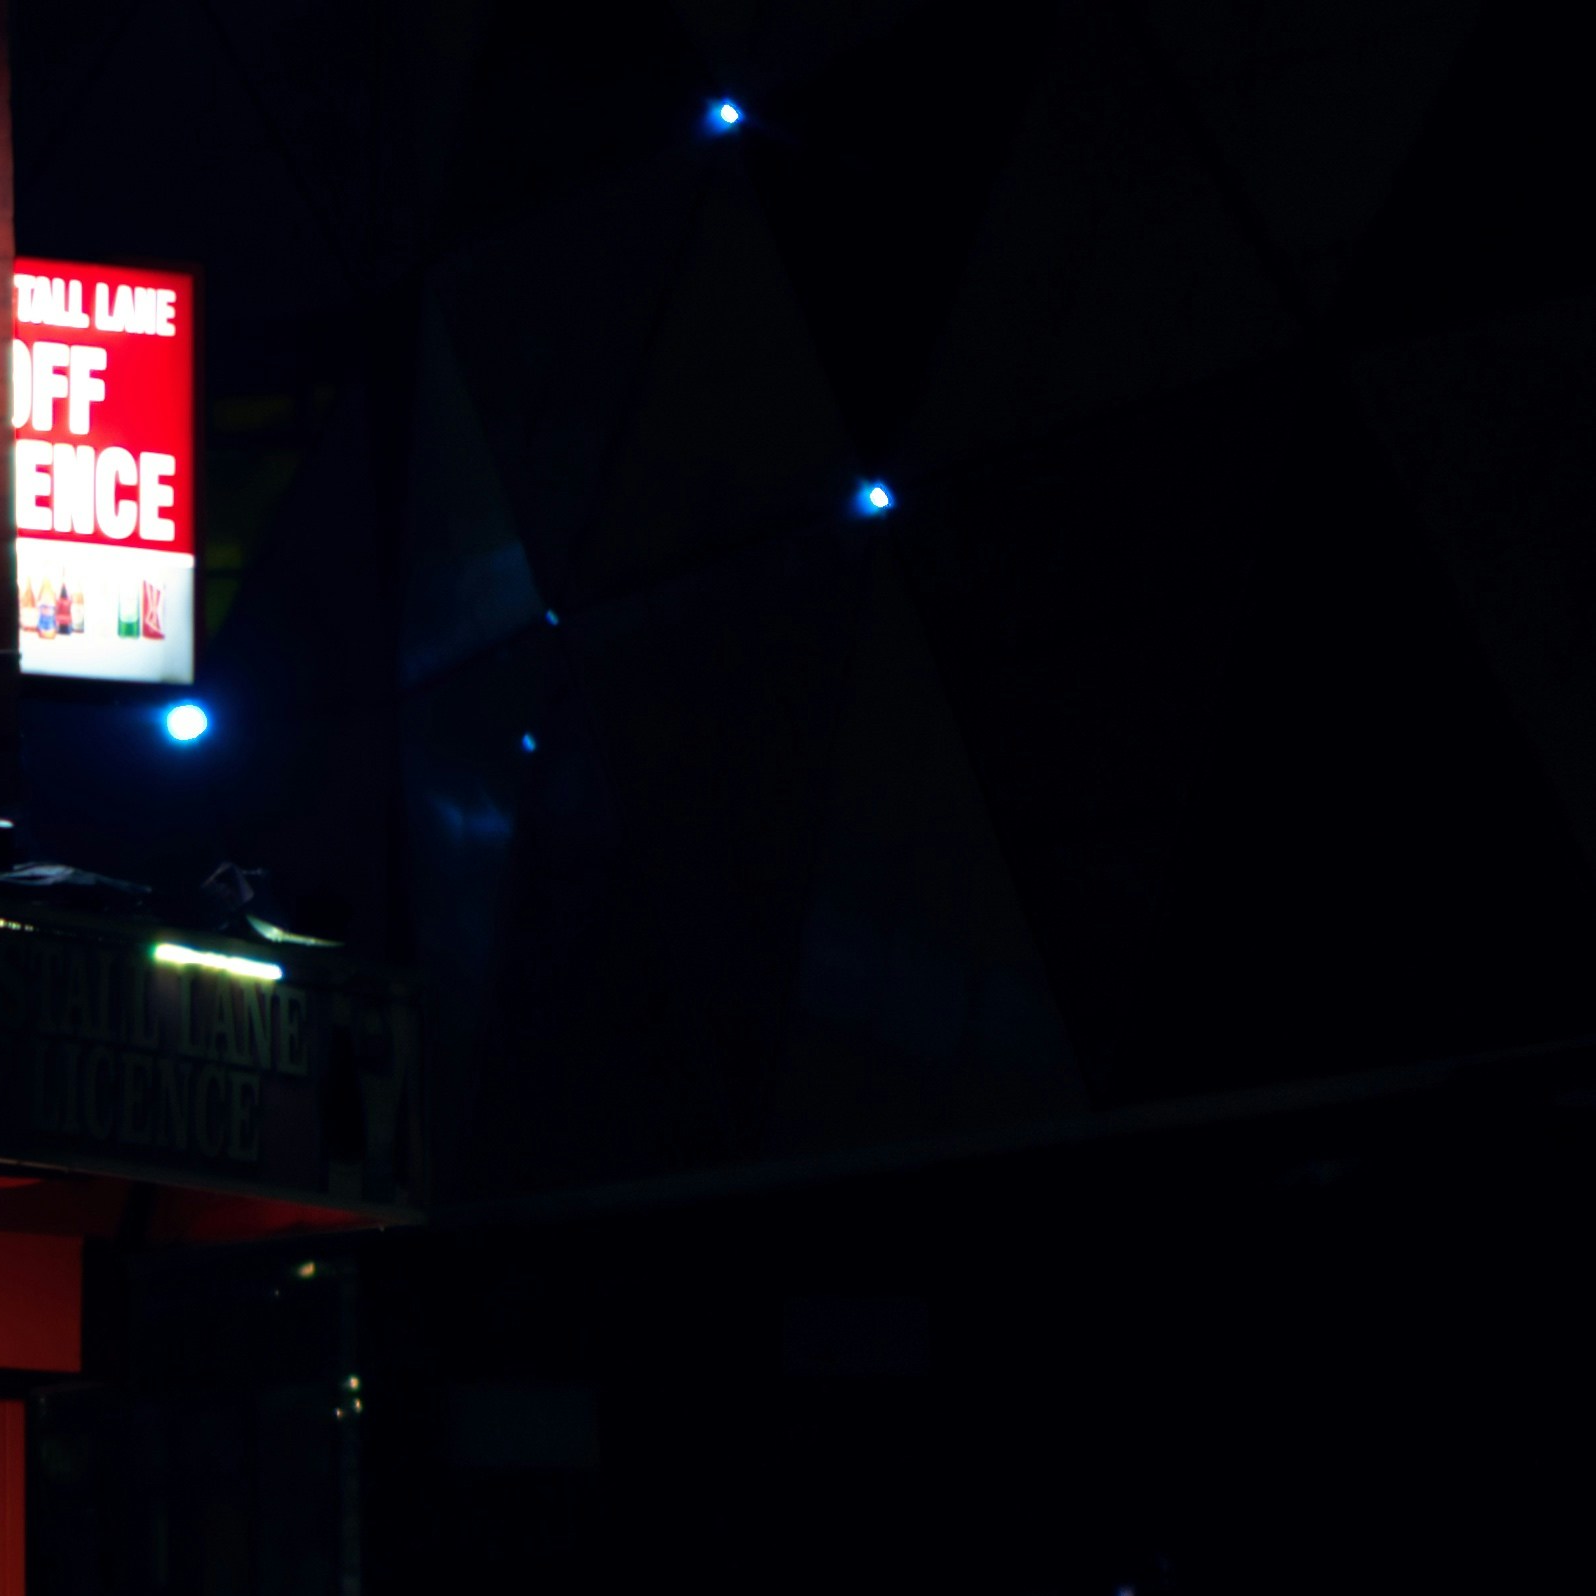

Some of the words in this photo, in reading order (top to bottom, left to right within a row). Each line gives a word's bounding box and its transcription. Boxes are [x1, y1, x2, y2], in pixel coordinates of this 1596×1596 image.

[96, 282, 177, 337] LANE
[14, 438, 177, 542] ENCE
[177, 960, 312, 1077] LANE
[33, 1036, 262, 1163] LICENCE
